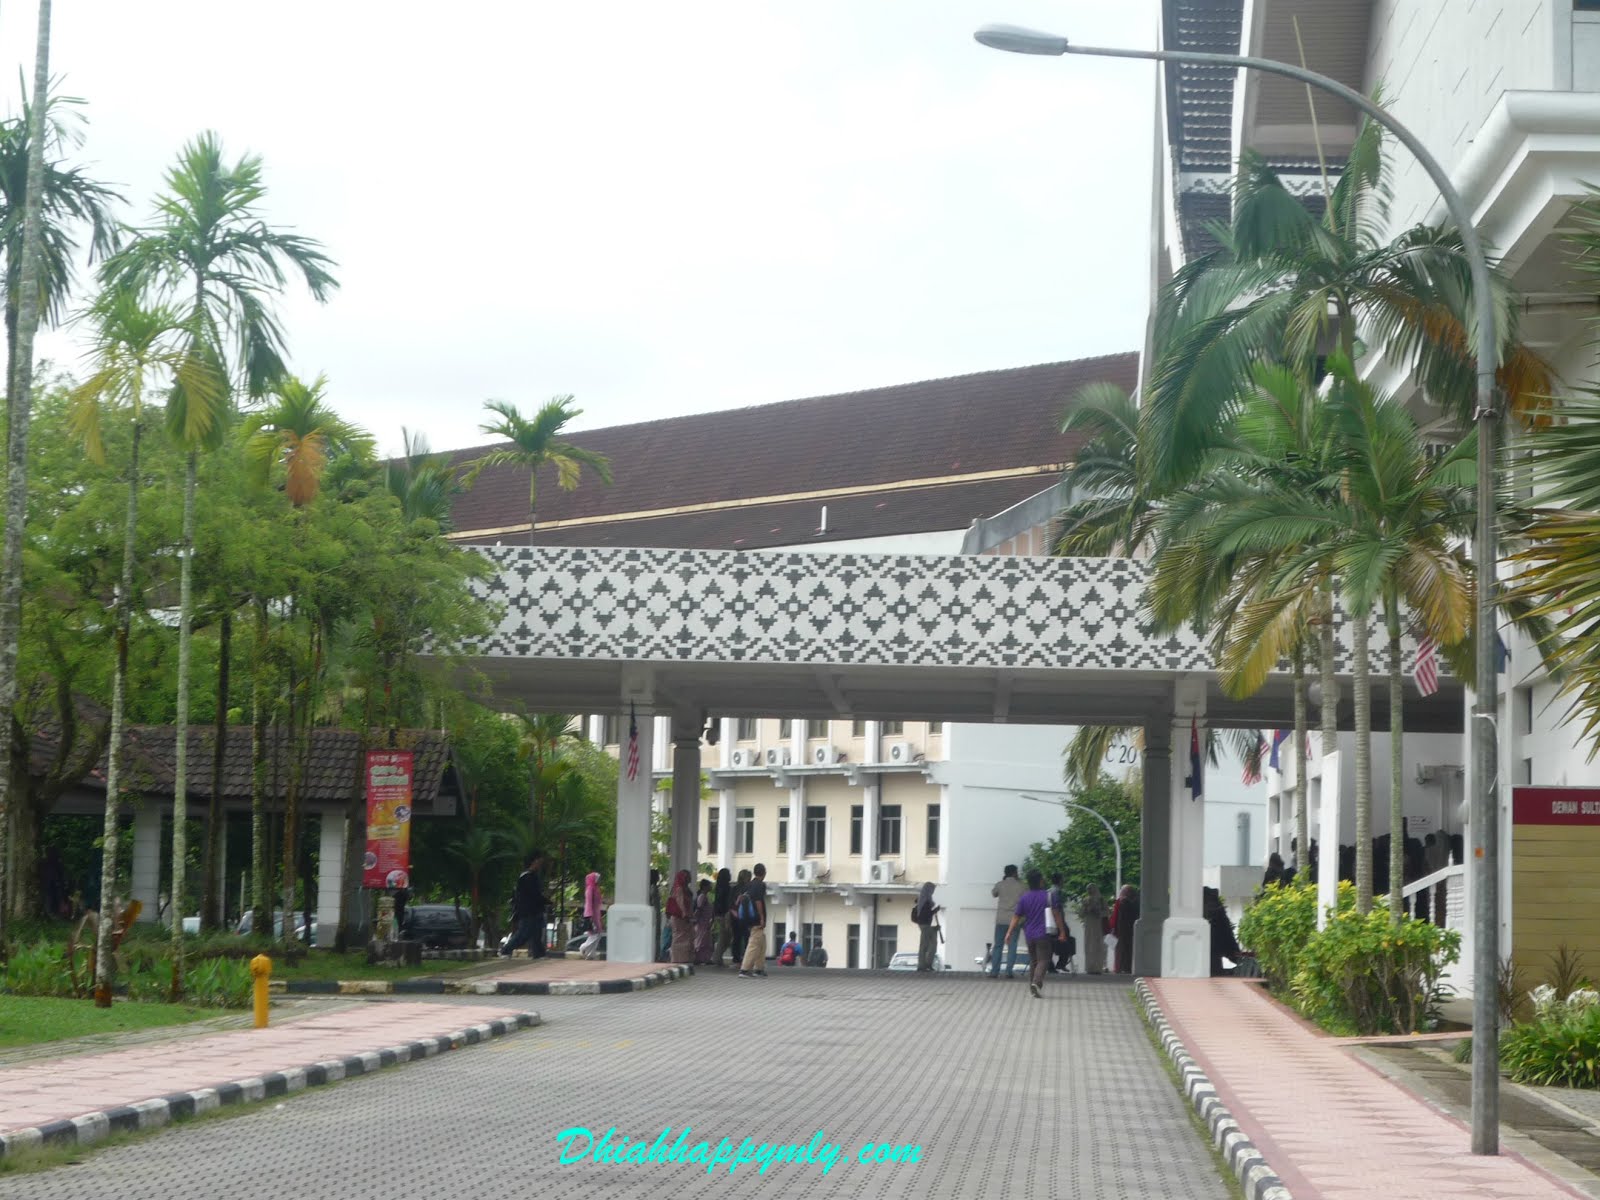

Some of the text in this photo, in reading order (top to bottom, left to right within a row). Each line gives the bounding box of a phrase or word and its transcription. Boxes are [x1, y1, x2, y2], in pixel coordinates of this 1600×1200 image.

[1105, 744, 1137, 764] C 20
[1551, 800, 1600, 815] DEWAN SULT
